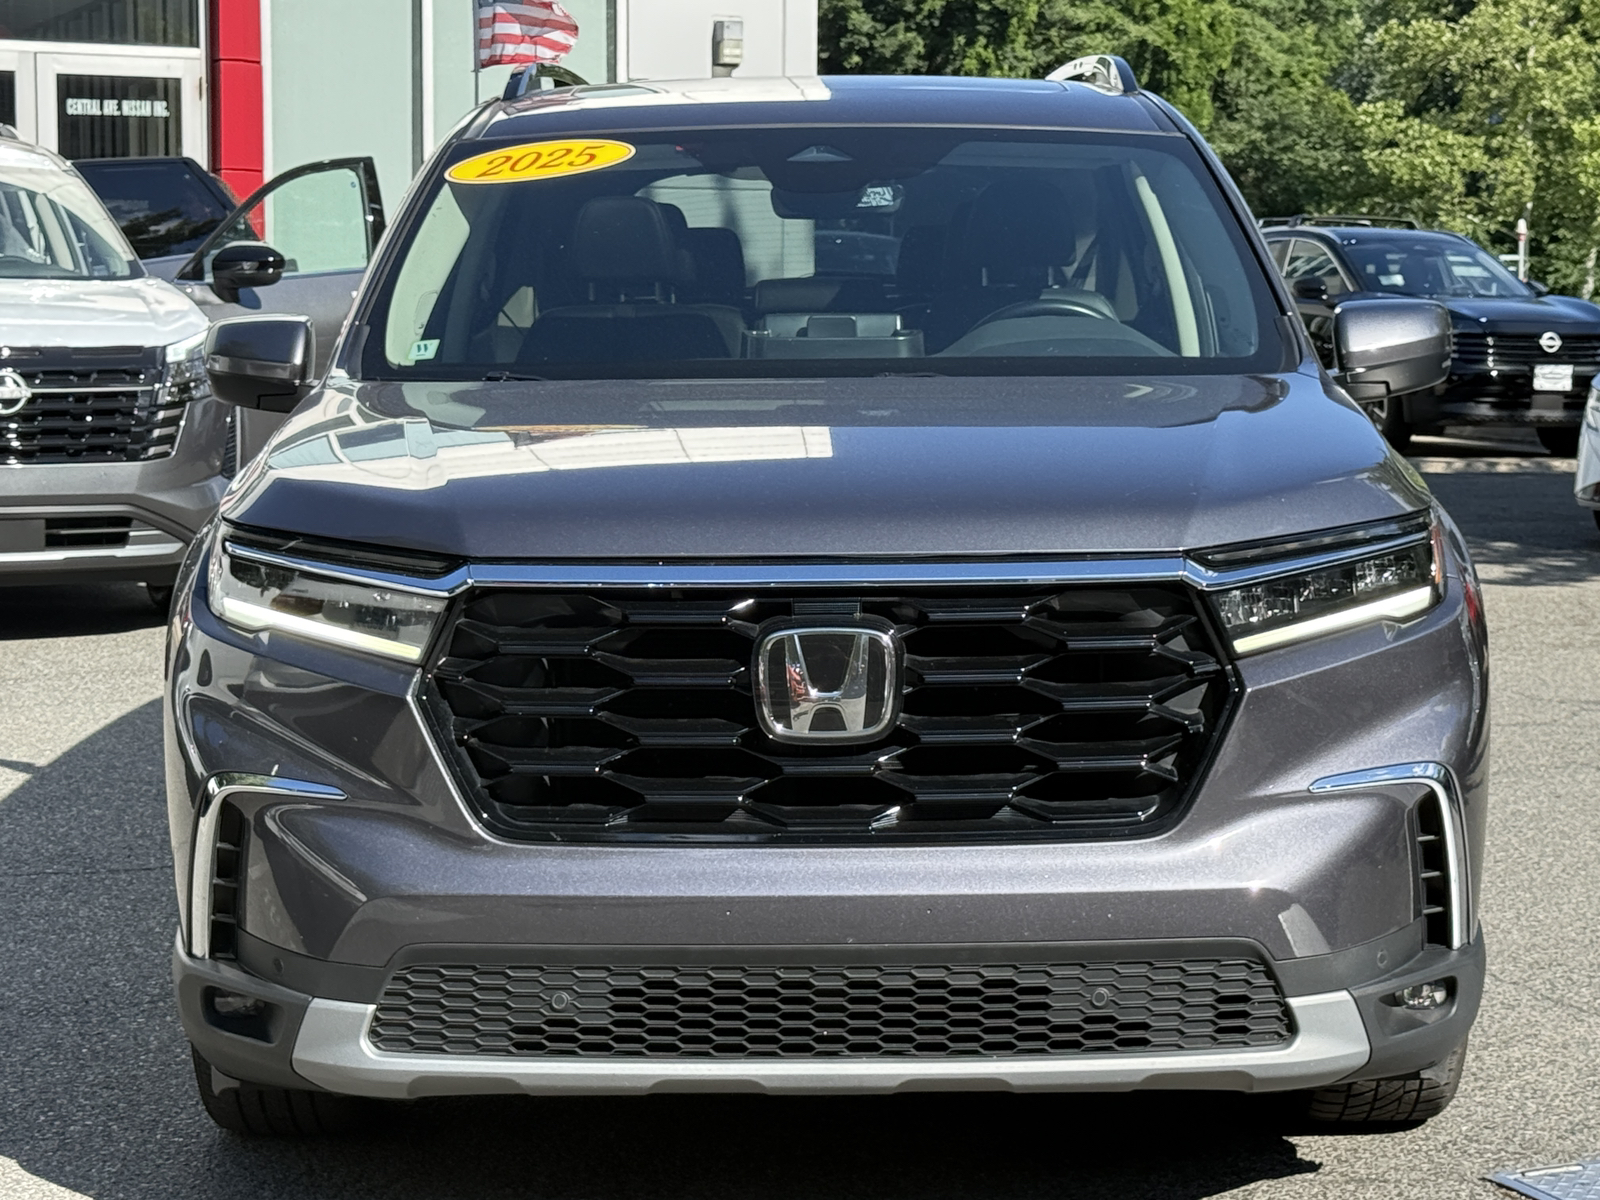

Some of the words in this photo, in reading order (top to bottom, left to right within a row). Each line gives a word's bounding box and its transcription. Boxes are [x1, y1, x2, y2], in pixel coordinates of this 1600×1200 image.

[66, 98, 102, 116] CENTRAL
[121, 99, 152, 117] NISSAN
[475, 145, 606, 178] 2025
